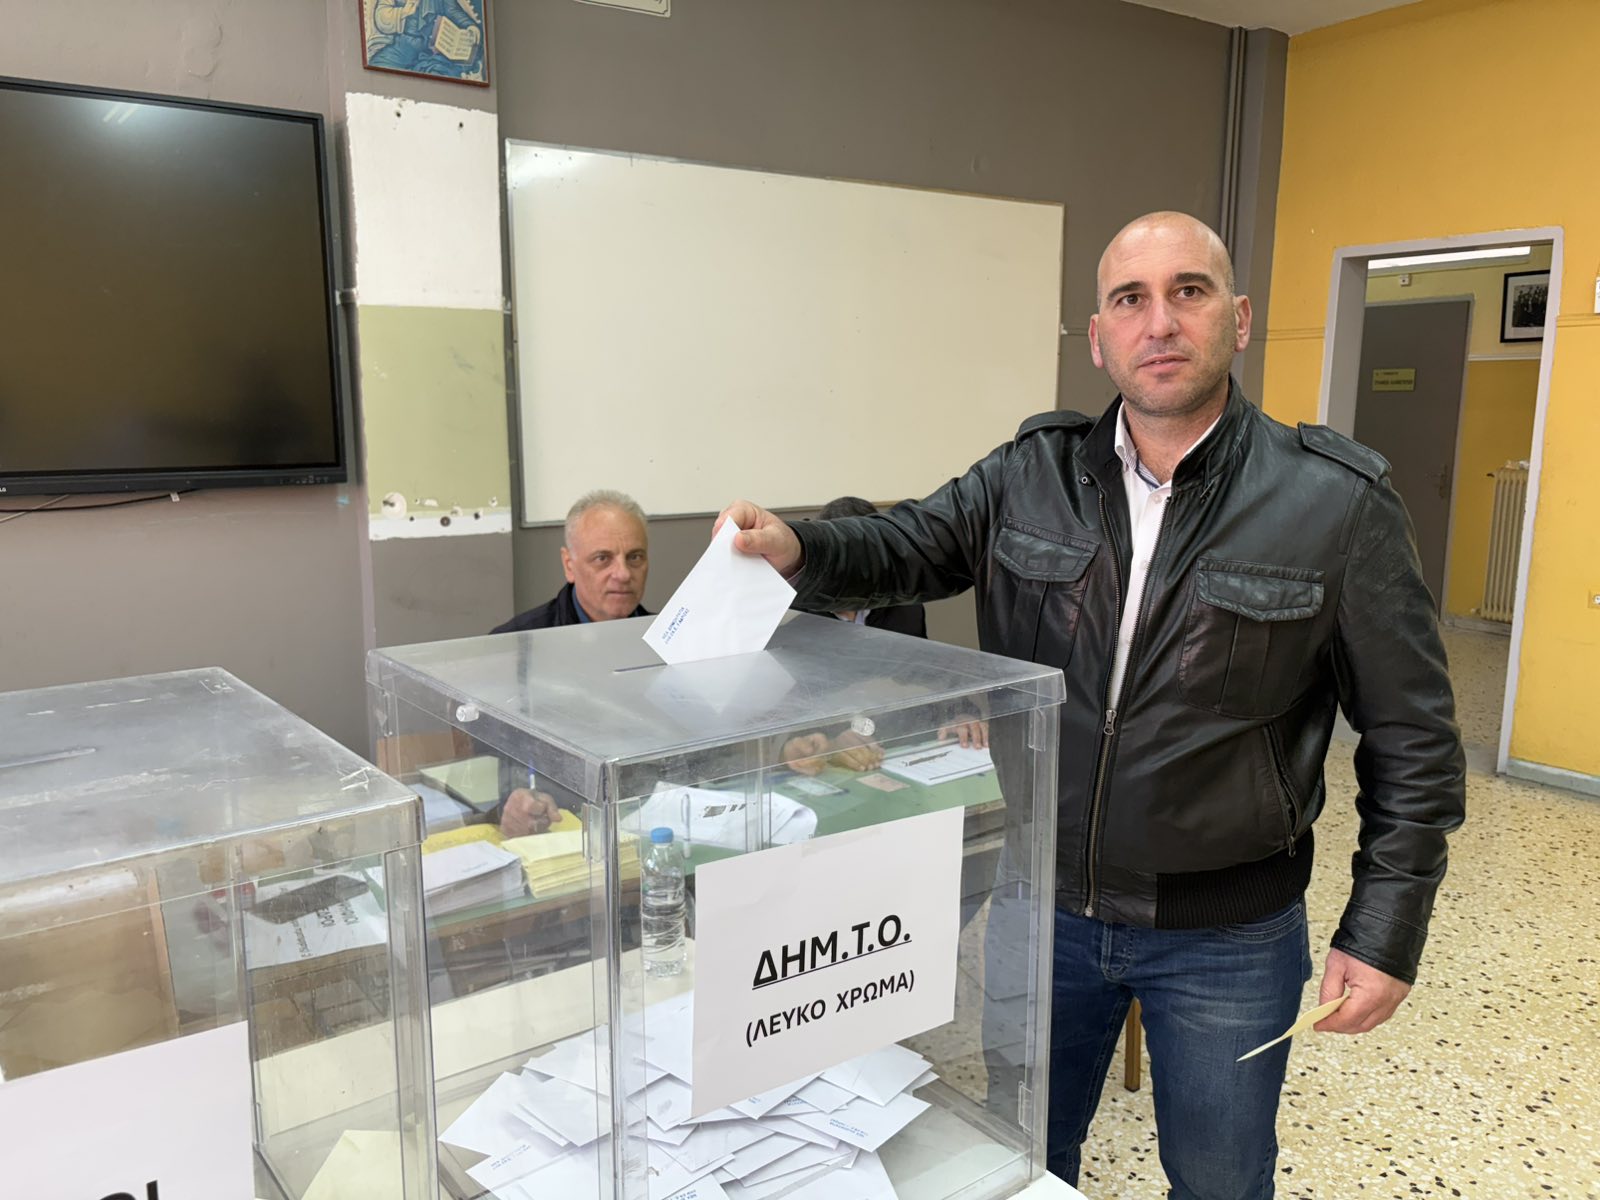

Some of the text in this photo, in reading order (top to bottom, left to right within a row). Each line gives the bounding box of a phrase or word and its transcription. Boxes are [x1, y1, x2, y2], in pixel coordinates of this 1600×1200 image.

[753, 914, 911, 987] ΔΗΜ.Τ.Ο.
[746, 970, 914, 1047] (ΛΕΥΚΟ ΧΡΩΜΑ)
